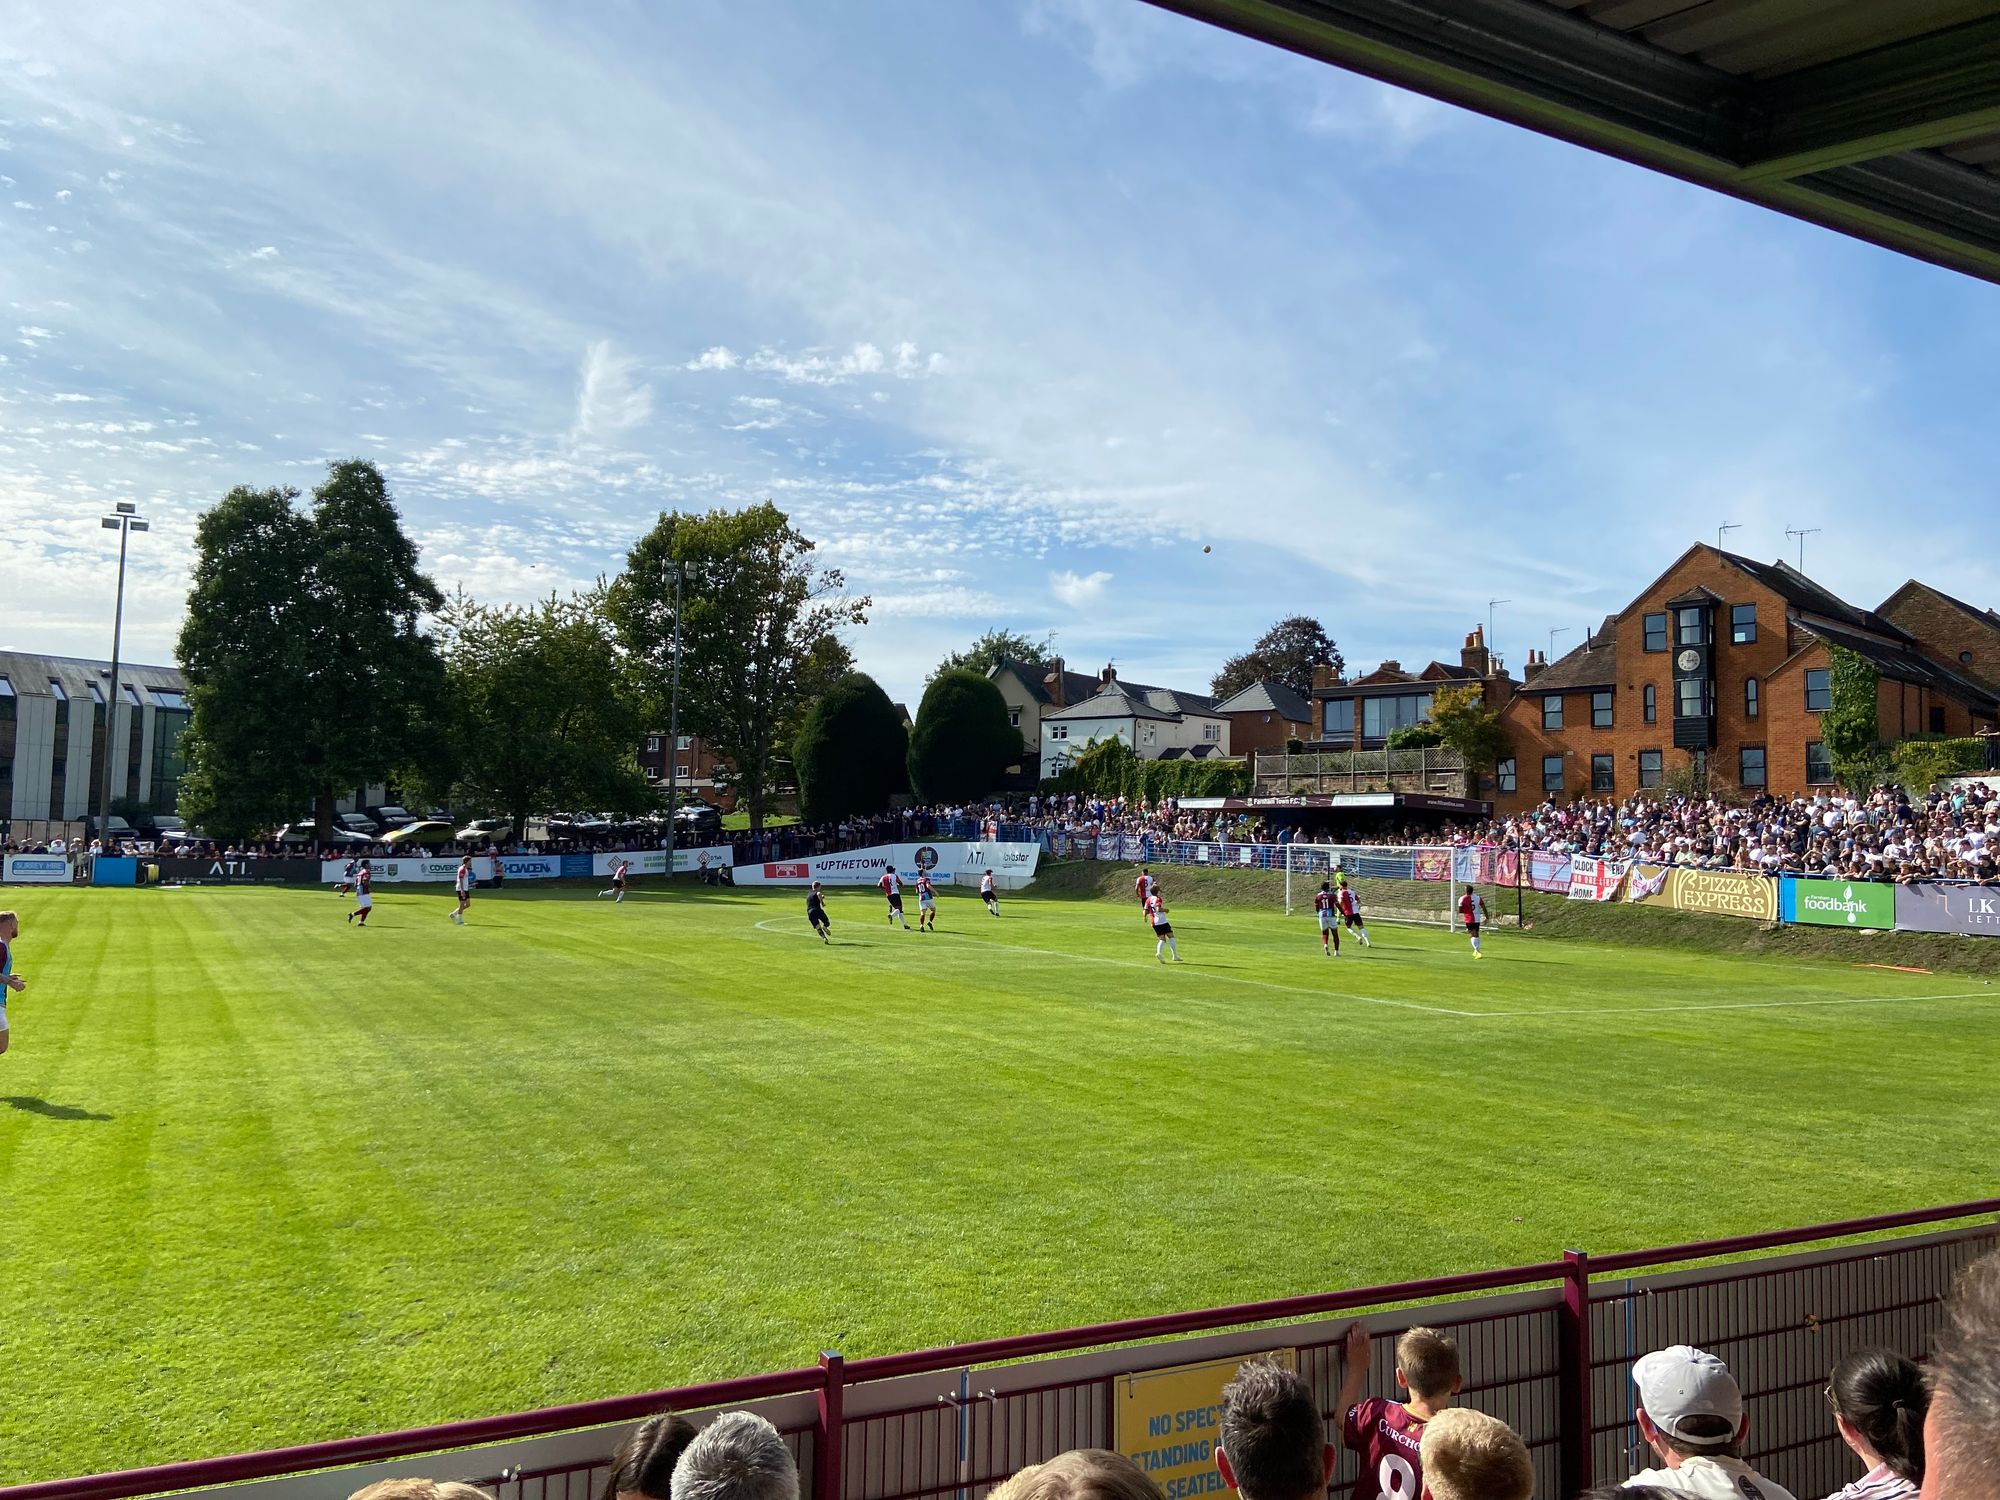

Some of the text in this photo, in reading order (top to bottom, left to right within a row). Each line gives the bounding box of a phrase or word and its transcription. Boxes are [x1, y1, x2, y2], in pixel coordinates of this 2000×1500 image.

[429, 864, 460, 872] COVERS
[1574, 859, 1594, 873] CLOCK
[1699, 875, 1750, 896] PIZZA
[1321, 898, 1330, 909] 11
[1684, 890, 1765, 913] EXPRESS
[1804, 896, 1867, 912] foodbank
[1969, 897, 1996, 914] LK
[1149, 1413, 1172, 1438] NO
